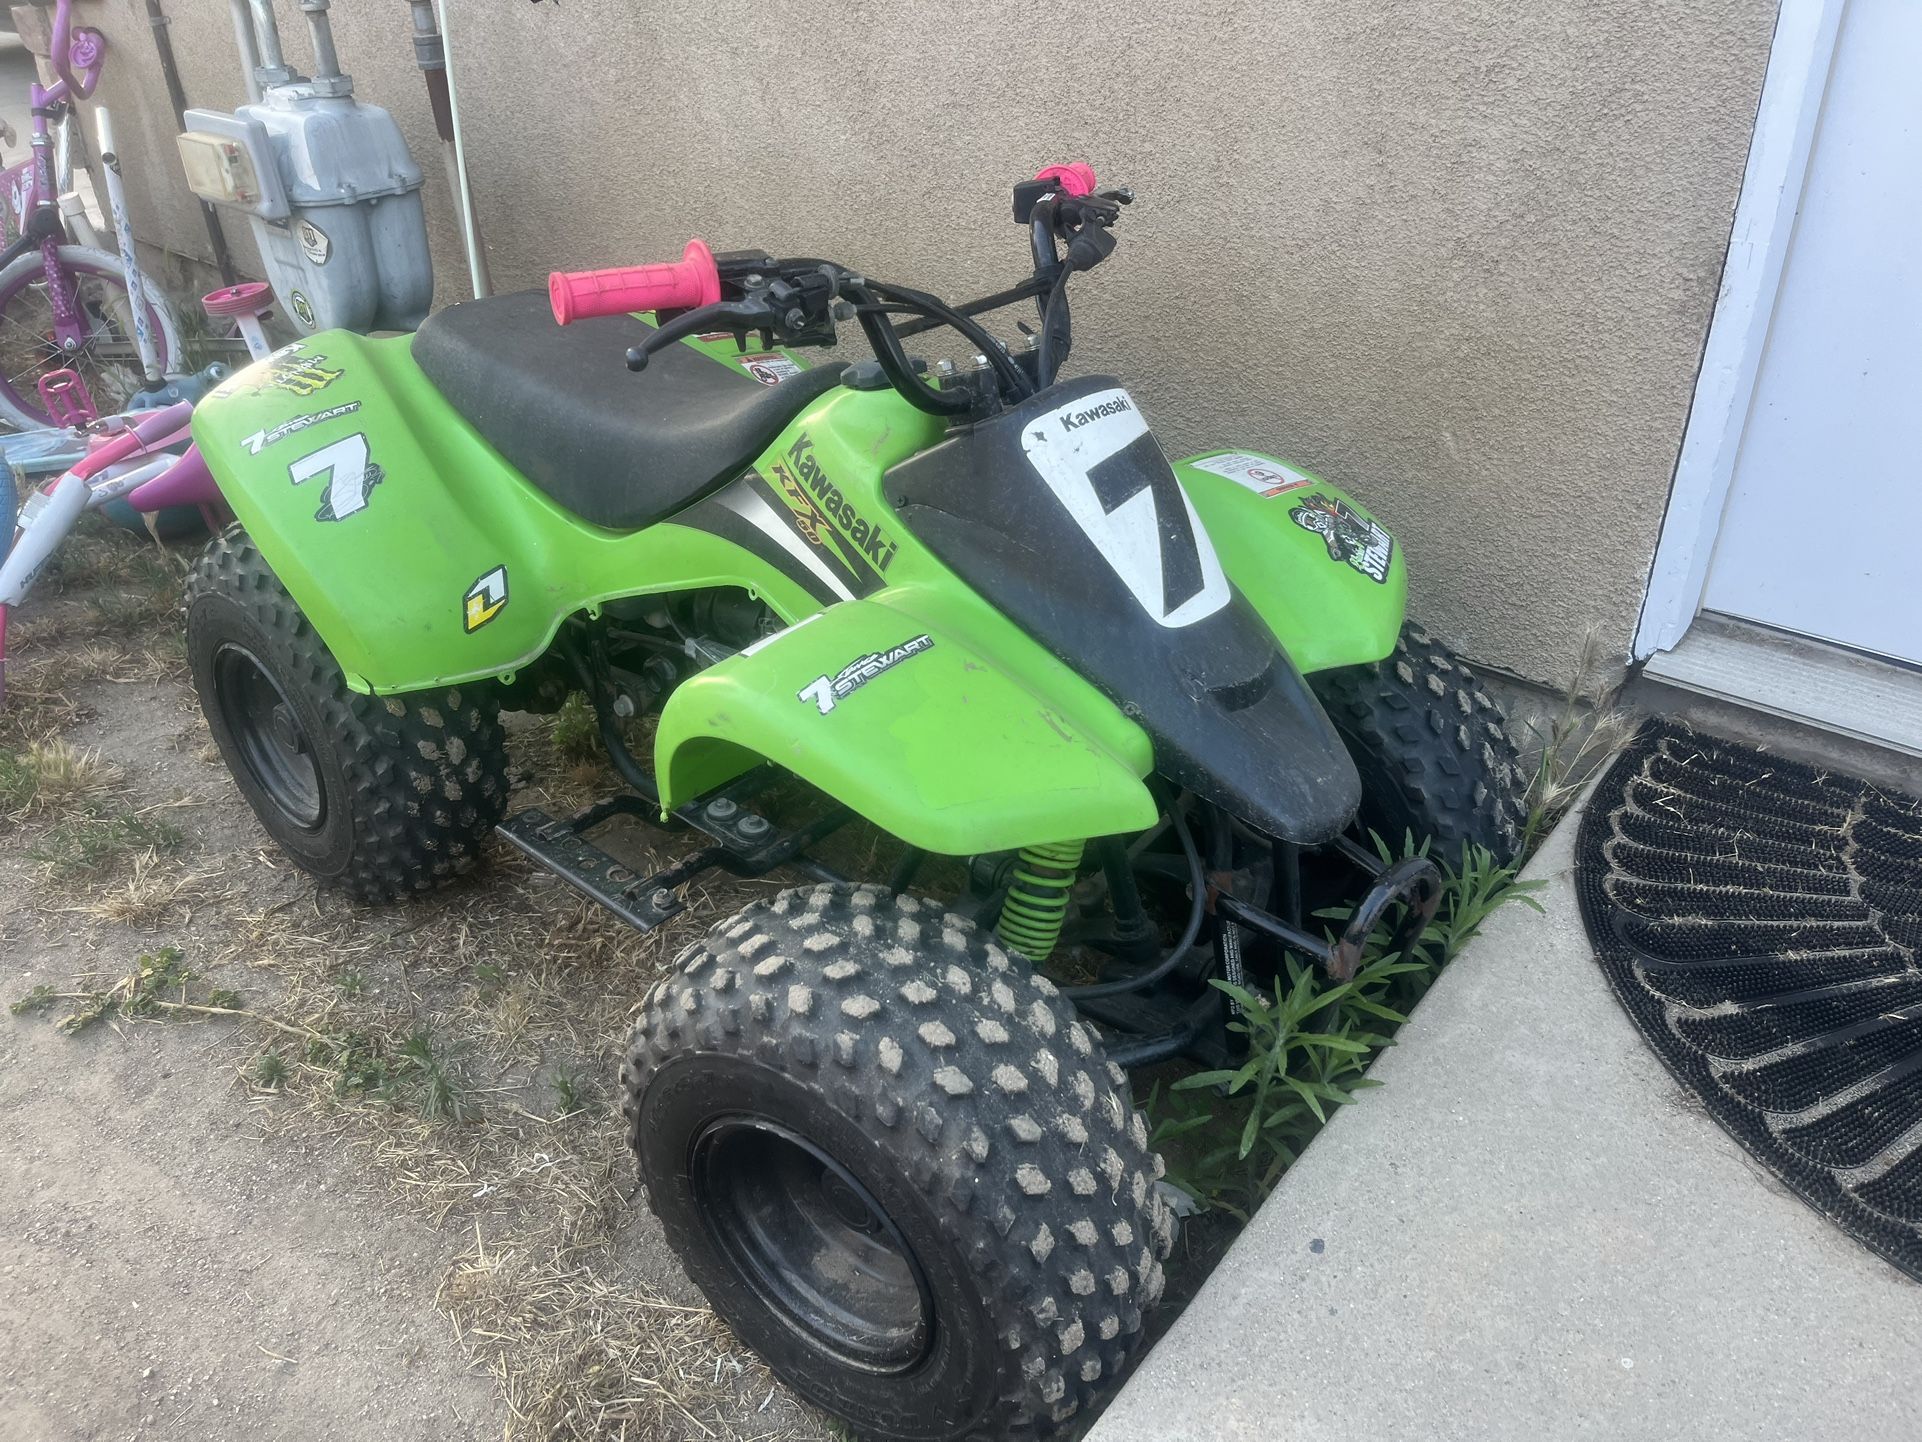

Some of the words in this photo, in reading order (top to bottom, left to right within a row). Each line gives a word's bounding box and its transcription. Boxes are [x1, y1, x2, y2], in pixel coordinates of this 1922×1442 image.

[266, 402, 359, 443] STEWART
[1059, 395, 1133, 433] Kawasaki
[290, 433, 368, 519] 7
[771, 463, 832, 536] KFX
[787, 431, 898, 572] Kawasaki
[1085, 430, 1205, 617] 7
[799, 675, 834, 714] 7
[834, 634, 930, 697] STEWART
